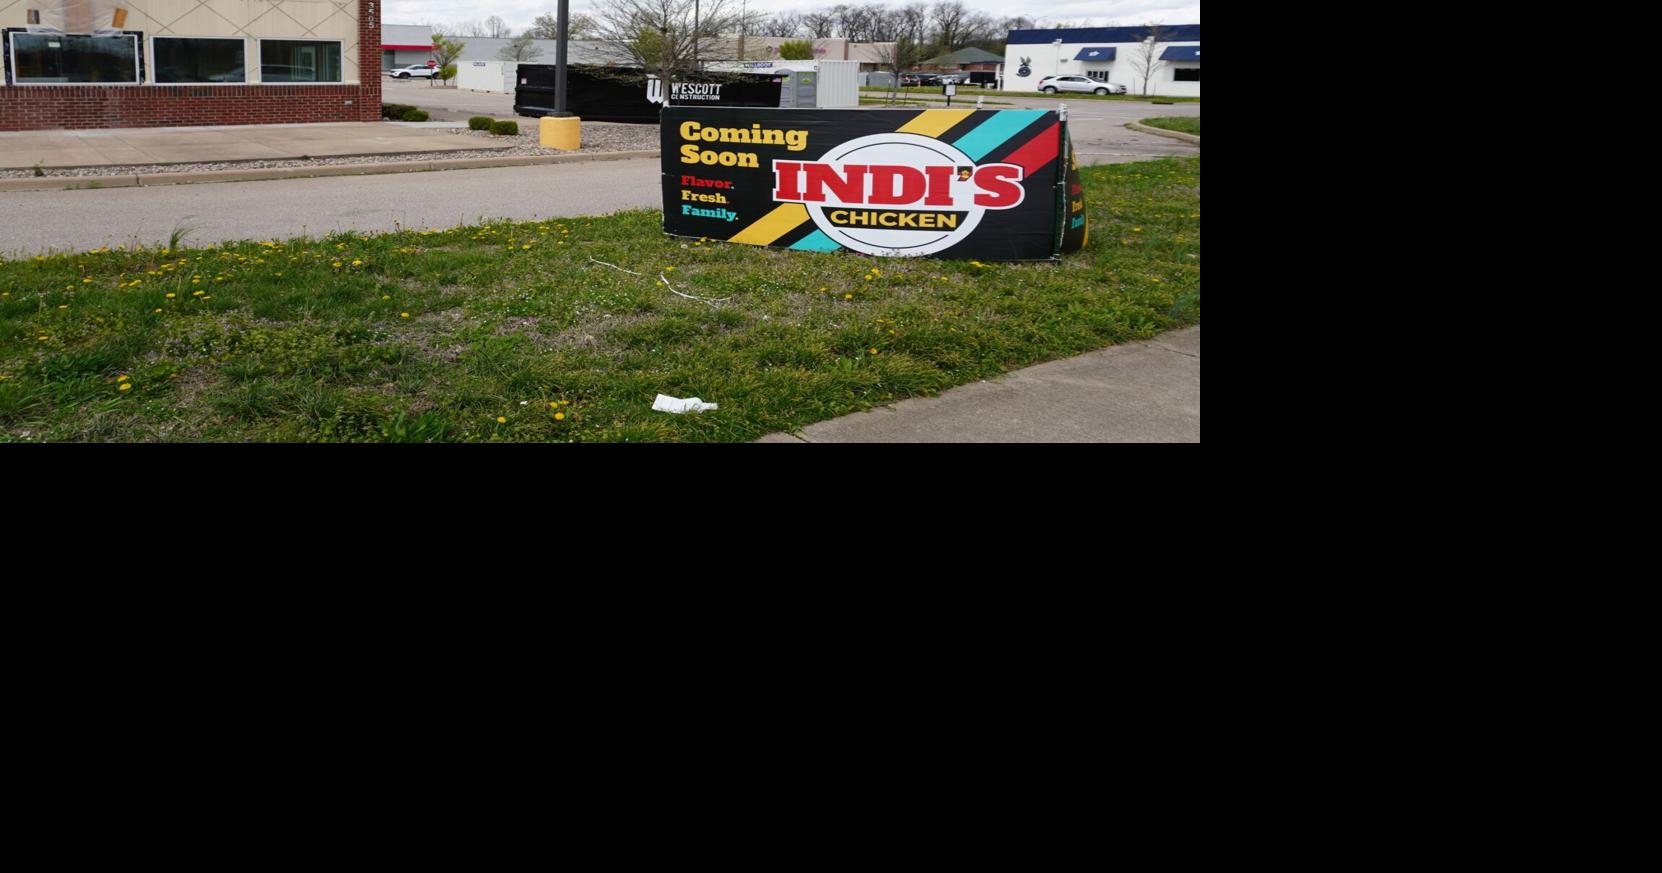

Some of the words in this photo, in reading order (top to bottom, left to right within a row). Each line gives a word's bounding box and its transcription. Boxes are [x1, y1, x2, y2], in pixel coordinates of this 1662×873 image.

[671, 83, 723, 95] WESCOTT
[680, 121, 809, 151] Coming
[680, 144, 759, 168] Soon
[681, 175, 735, 189] Flavor.
[774, 161, 1023, 208] INDI'S
[682, 205, 739, 222] Family.
[830, 210, 957, 228] CHICKEN
